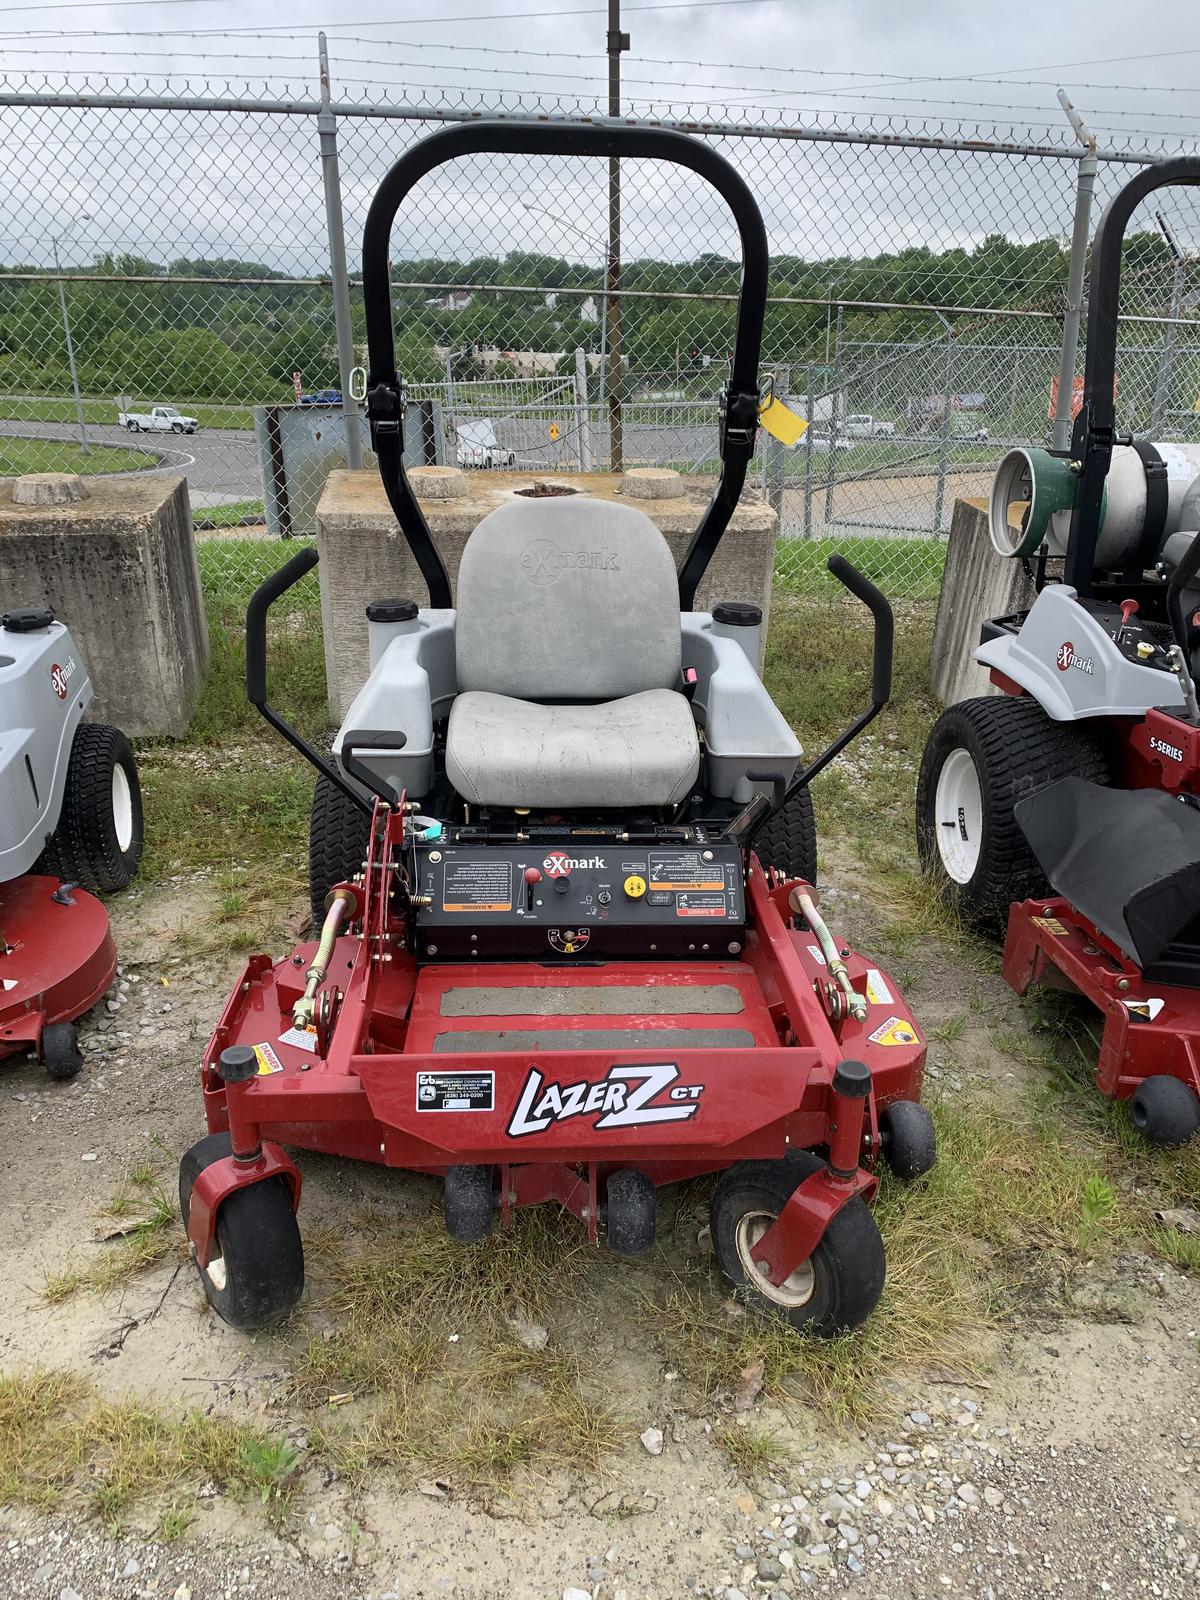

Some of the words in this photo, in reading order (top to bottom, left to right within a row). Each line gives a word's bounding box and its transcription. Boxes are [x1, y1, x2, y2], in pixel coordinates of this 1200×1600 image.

[1149, 736, 1184, 762] S-SERIES
[872, 1019, 897, 1040] DANGER
[260, 1044, 281, 1070] DANGER
[419, 1075, 436, 1085] Erb
[506, 1069, 628, 1138] LAZER
[594, 1063, 698, 1129] Z
[670, 1085, 704, 1100] CT
